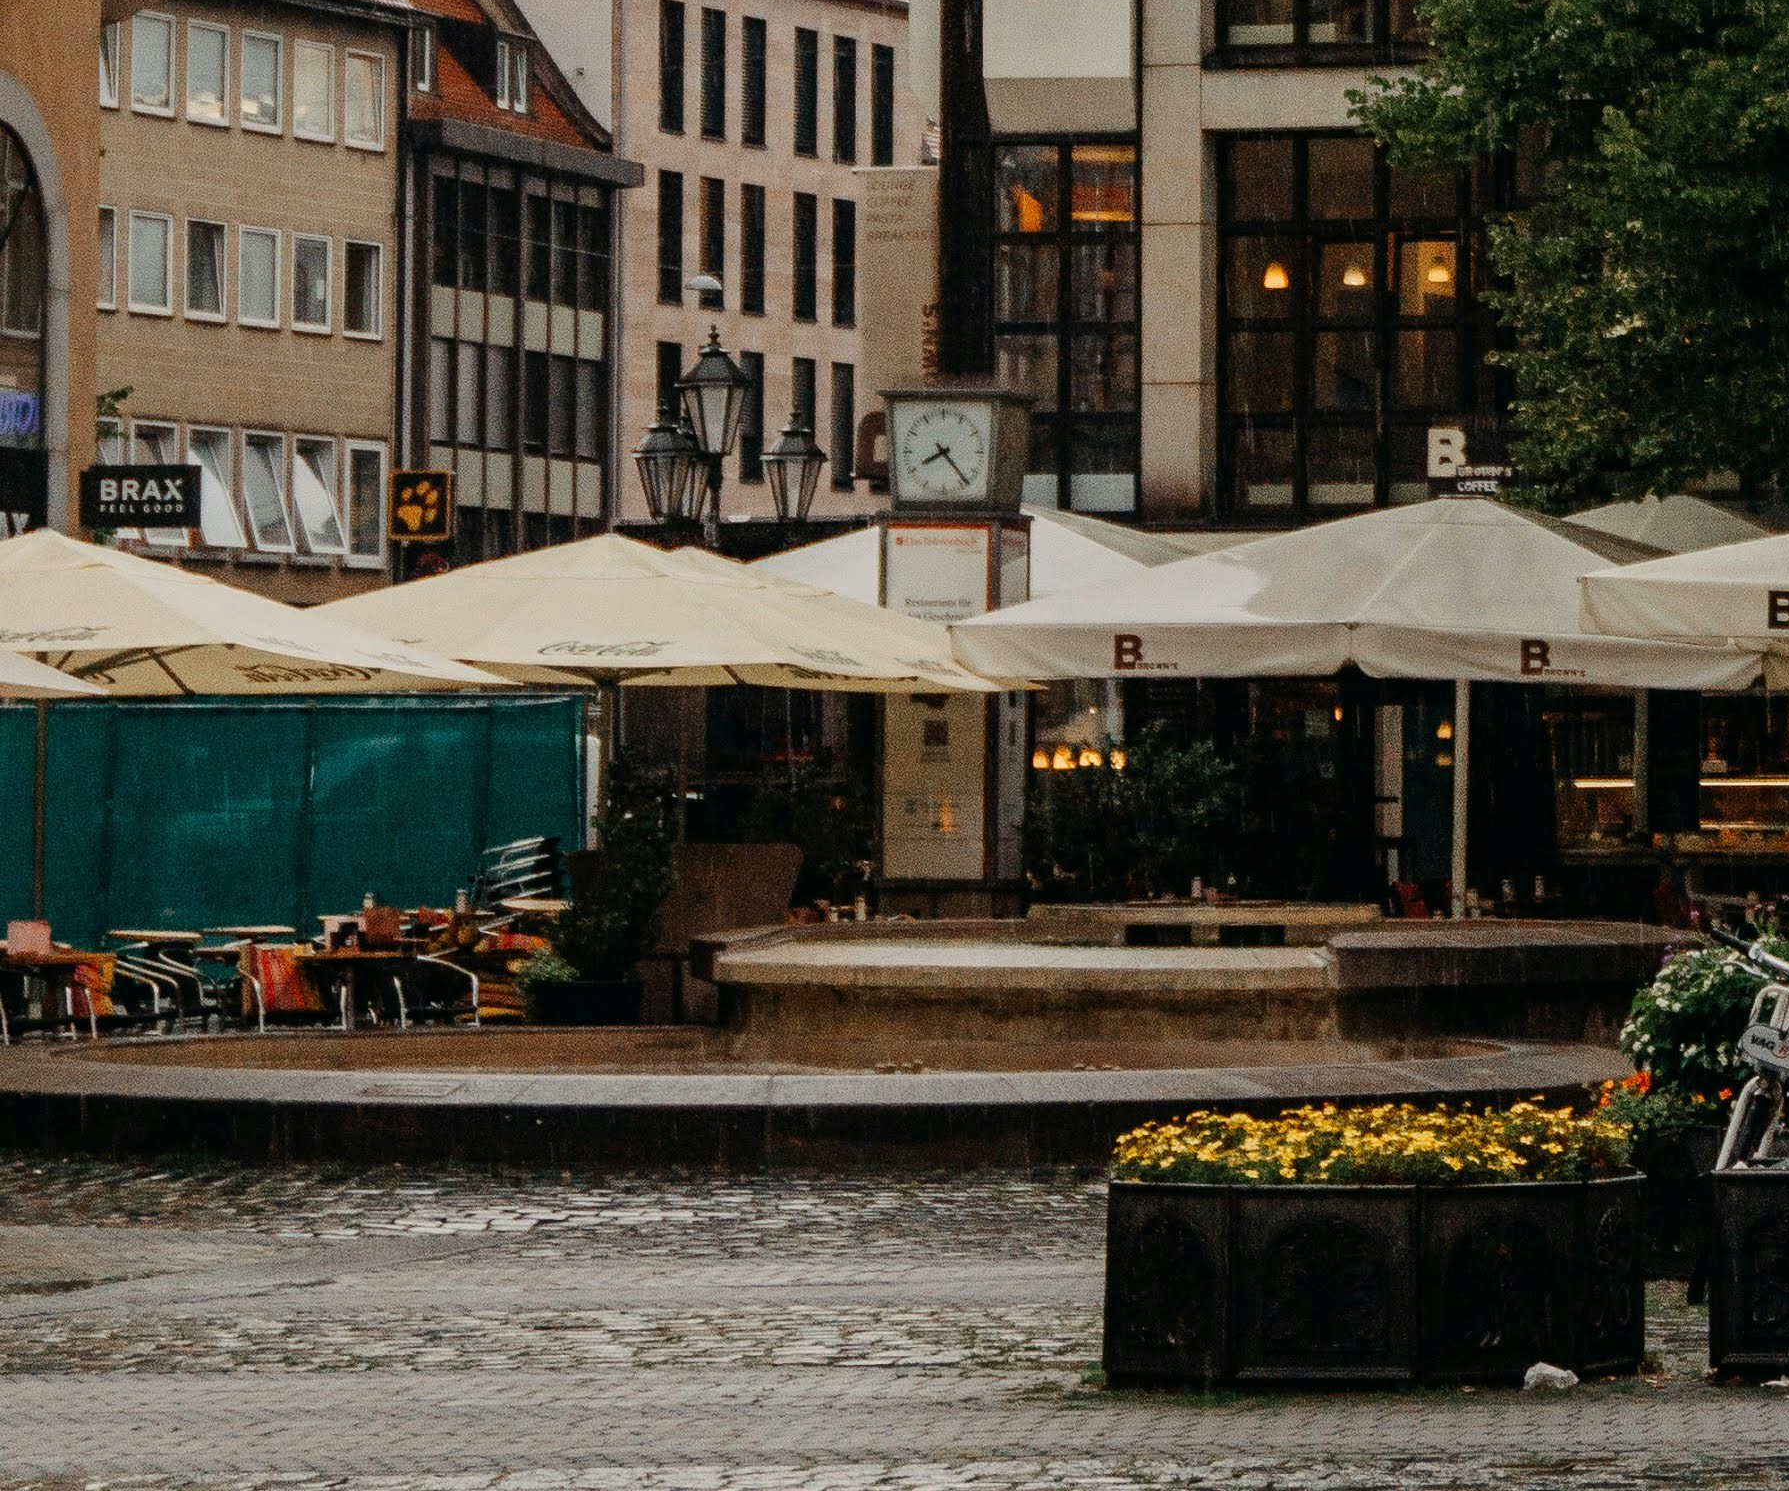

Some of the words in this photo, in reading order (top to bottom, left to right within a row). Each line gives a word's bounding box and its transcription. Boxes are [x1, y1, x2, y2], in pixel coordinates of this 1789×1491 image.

[1427, 428, 1466, 477] B
[100, 479, 183, 502] BRAX
[1457, 481, 1499, 492] COFFEE
[100, 504, 136, 513] FEEL
[143, 504, 185, 513] GOOD
[1114, 634, 1143, 670] B
[1521, 639, 1550, 675] B
[1750, 1035, 1775, 1051] VAG
